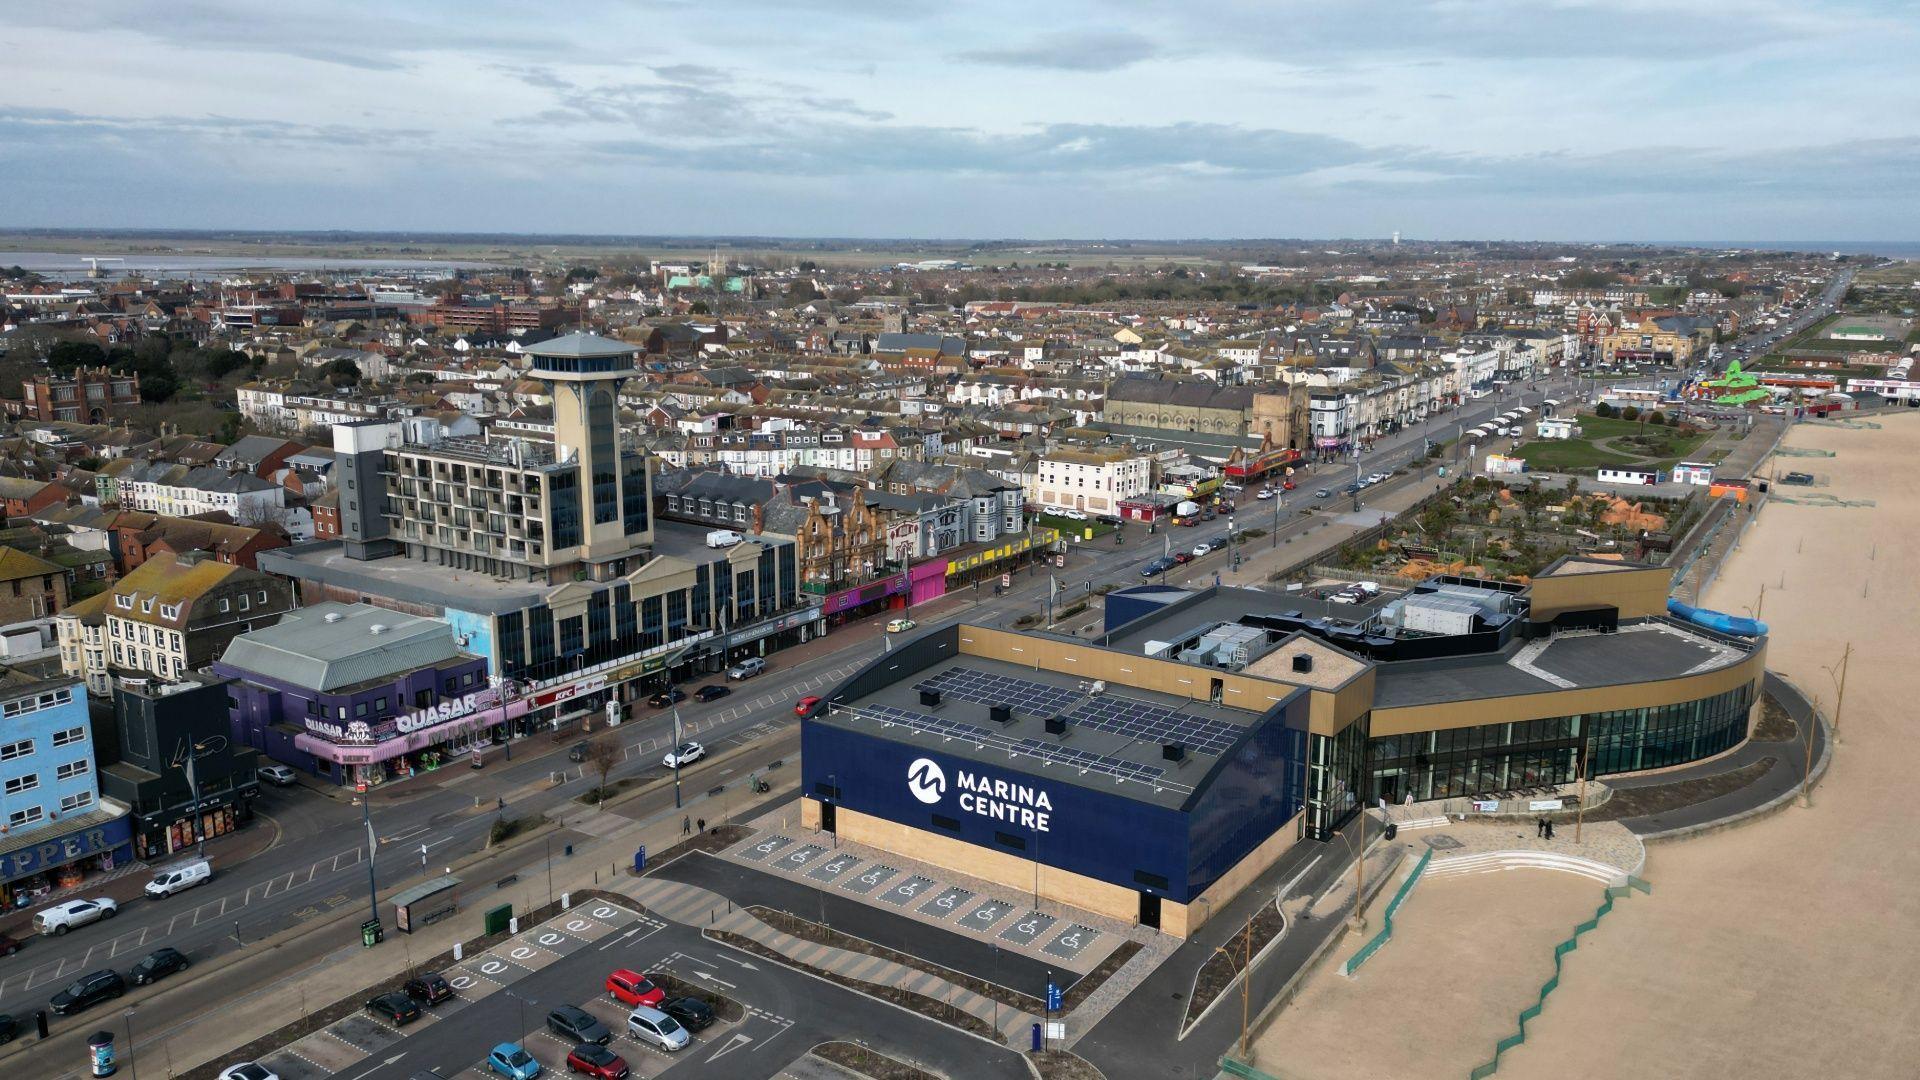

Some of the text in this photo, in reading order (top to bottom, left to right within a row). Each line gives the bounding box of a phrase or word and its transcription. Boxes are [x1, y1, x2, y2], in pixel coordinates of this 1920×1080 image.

[396, 694, 477, 733] QUASAR
[555, 689, 573, 700] KFC
[304, 717, 342, 738] QUASAR
[958, 770, 1052, 811] MARINA
[959, 793, 1050, 832] CENTRE
